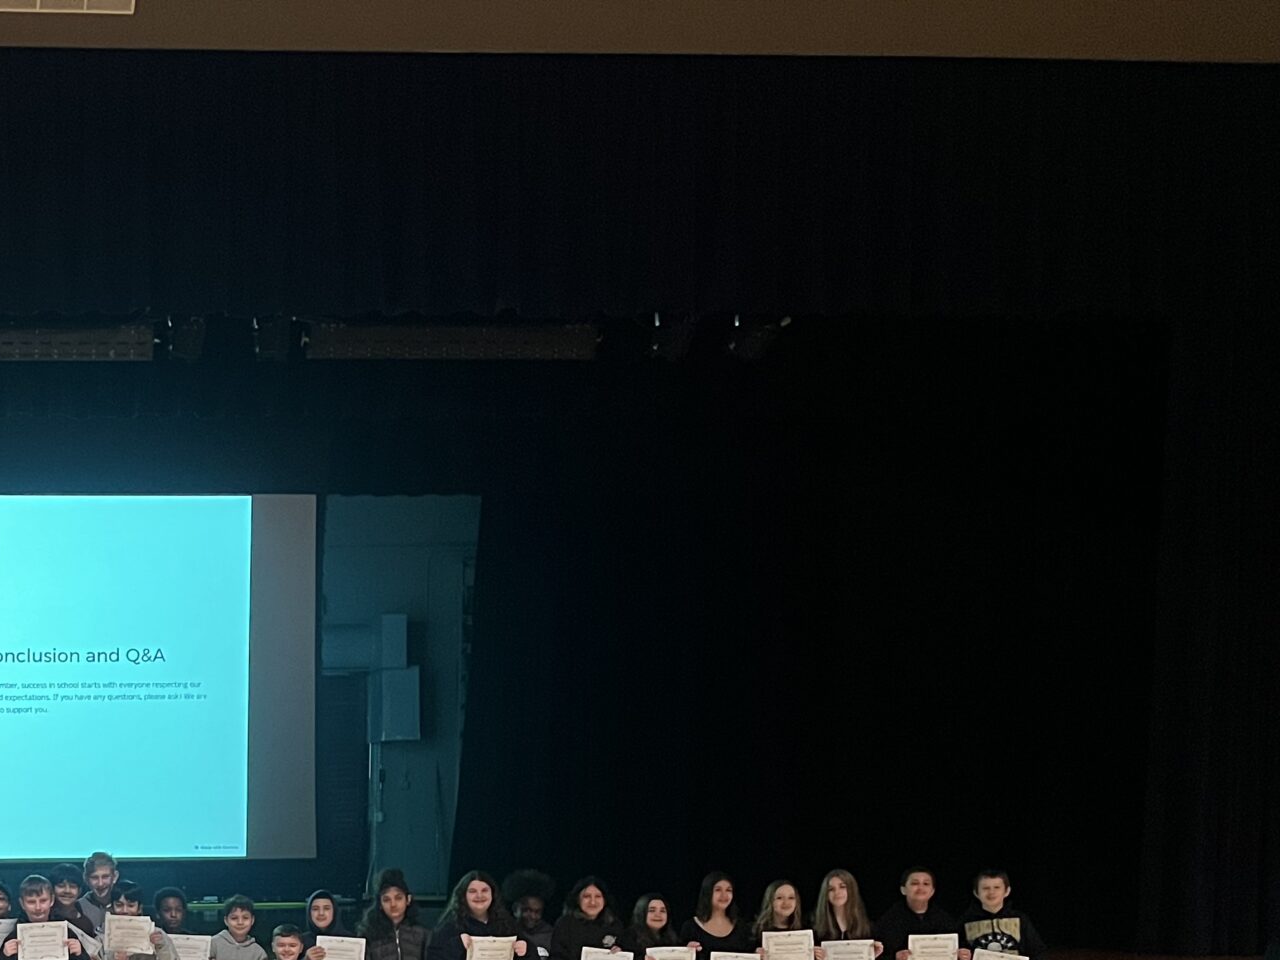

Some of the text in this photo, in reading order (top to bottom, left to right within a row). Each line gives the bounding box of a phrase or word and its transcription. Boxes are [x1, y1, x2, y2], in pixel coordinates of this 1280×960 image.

[85, 647, 120, 663] and
[125, 648, 166, 665] Q&A
[48, 681, 56, 689] in
[56, 681, 80, 689] school
[102, 681, 118, 689] with
[118, 682, 151, 690] everyone
[151, 681, 188, 690] respecting
[4, 693, 52, 702] expectations.
[60, 695, 74, 703] you
[74, 693, 92, 701] have
[92, 694, 106, 702] any
[107, 693, 143, 702] questions,
[143, 694, 166, 702] please
[6, 706, 33, 715] support
